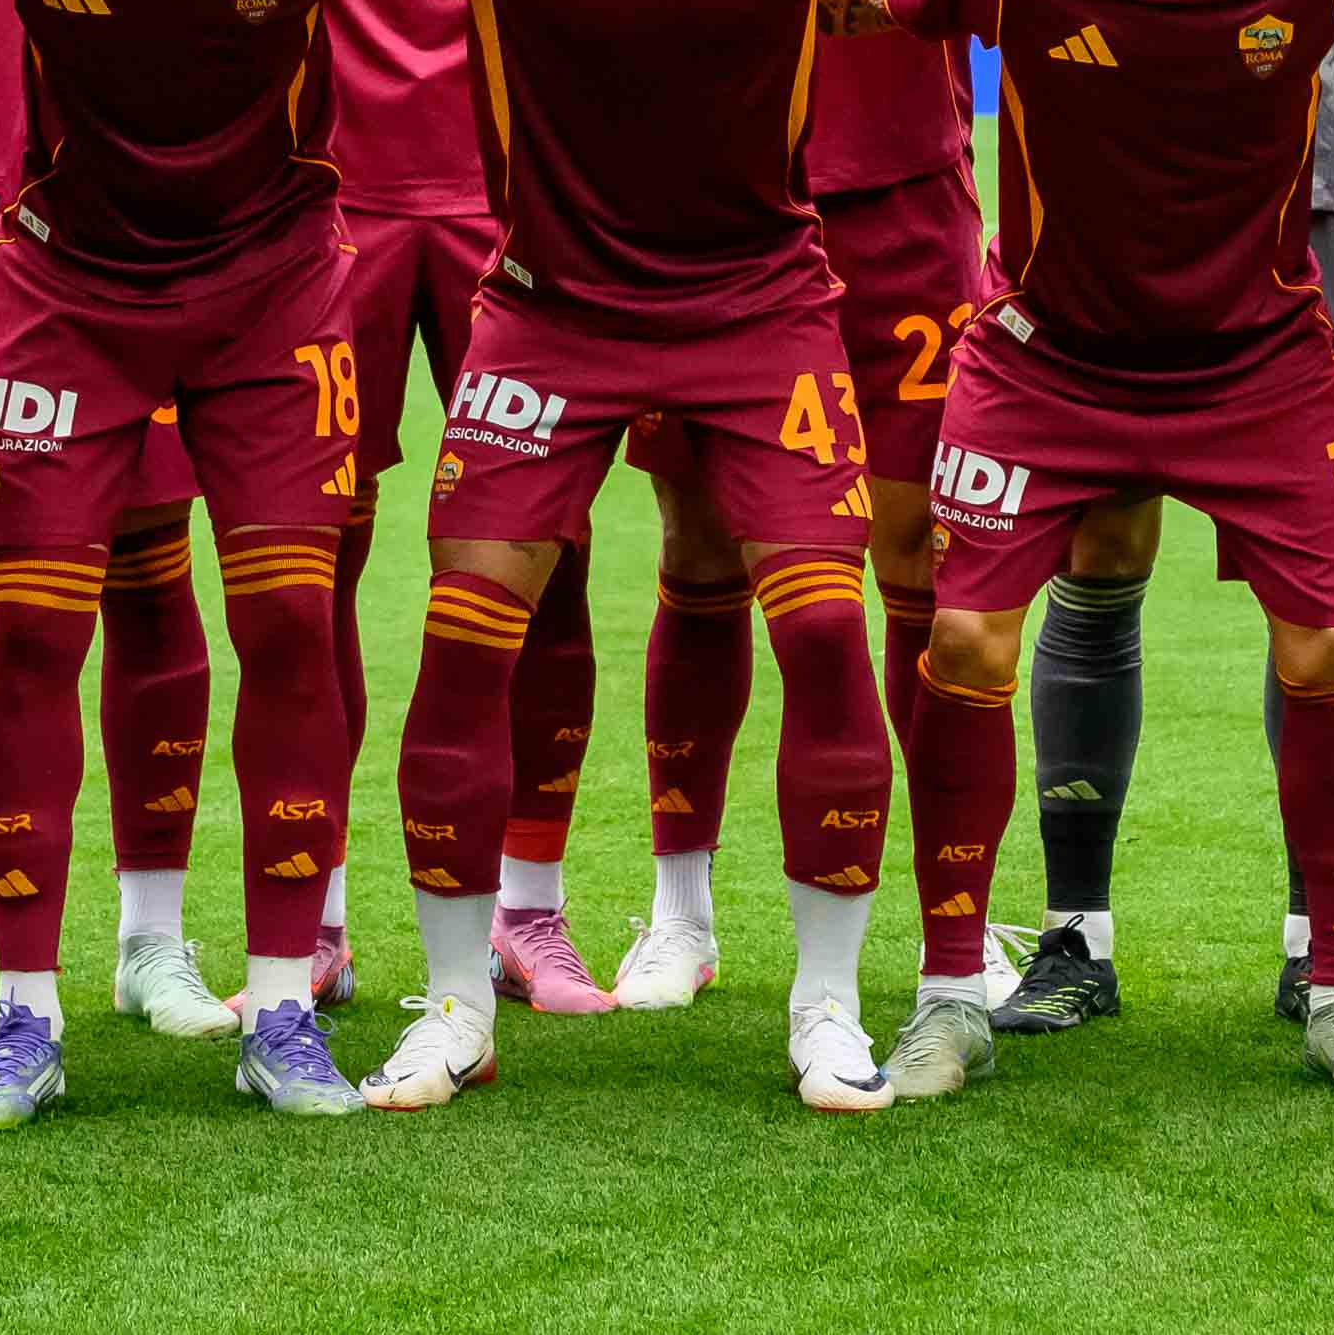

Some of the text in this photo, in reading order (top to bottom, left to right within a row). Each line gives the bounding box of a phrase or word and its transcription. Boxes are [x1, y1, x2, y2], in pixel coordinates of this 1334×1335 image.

[294, 340, 361, 438] 18
[449, 370, 568, 441] HDI
[779, 372, 867, 465] 43
[929, 440, 1031, 516] HDI
[152, 740, 204, 756] ASR
[269, 800, 327, 820] ASR
[821, 809, 881, 829] ASR
[405, 819, 458, 841] ASR
[937, 845, 985, 863] ASR
